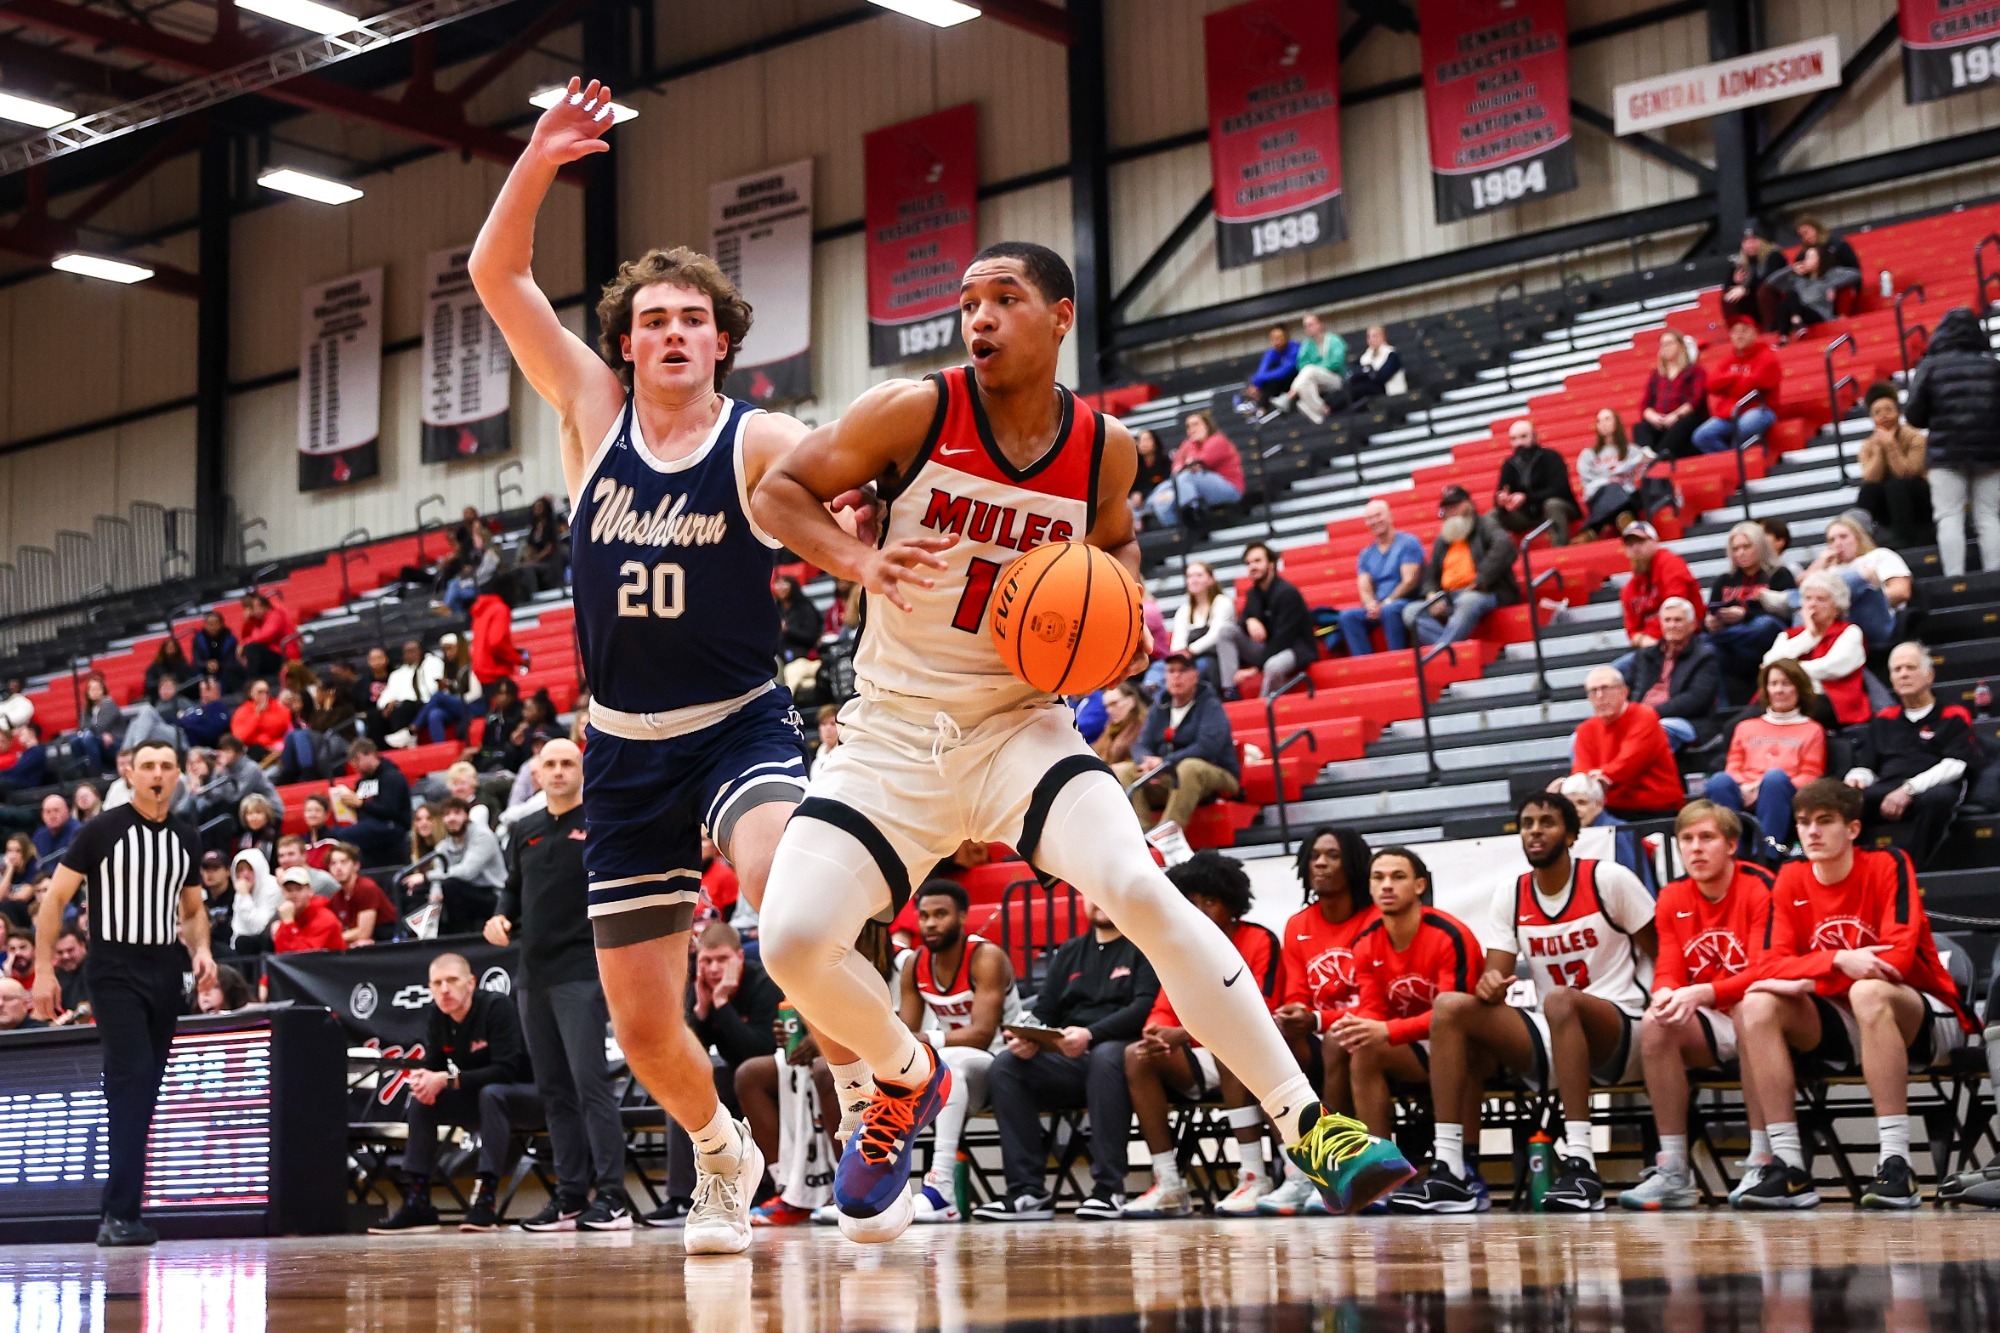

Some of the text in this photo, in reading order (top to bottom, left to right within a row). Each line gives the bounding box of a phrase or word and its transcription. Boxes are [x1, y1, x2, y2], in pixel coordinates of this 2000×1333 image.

[1628, 50, 1824, 120] GENERAL ADMISSION
[1471, 160, 1548, 209] 1984
[1251, 211, 1321, 257] 1938
[898, 316, 956, 356] 1937
[591, 476, 728, 548] Washburn
[920, 487, 1074, 552] MULES
[617, 560, 686, 619] 20
[951, 556, 1002, 634] 1
[1528, 928, 1599, 957] MULES
[784, 1018, 798, 1033] G
[1529, 1155, 1544, 1173] G
